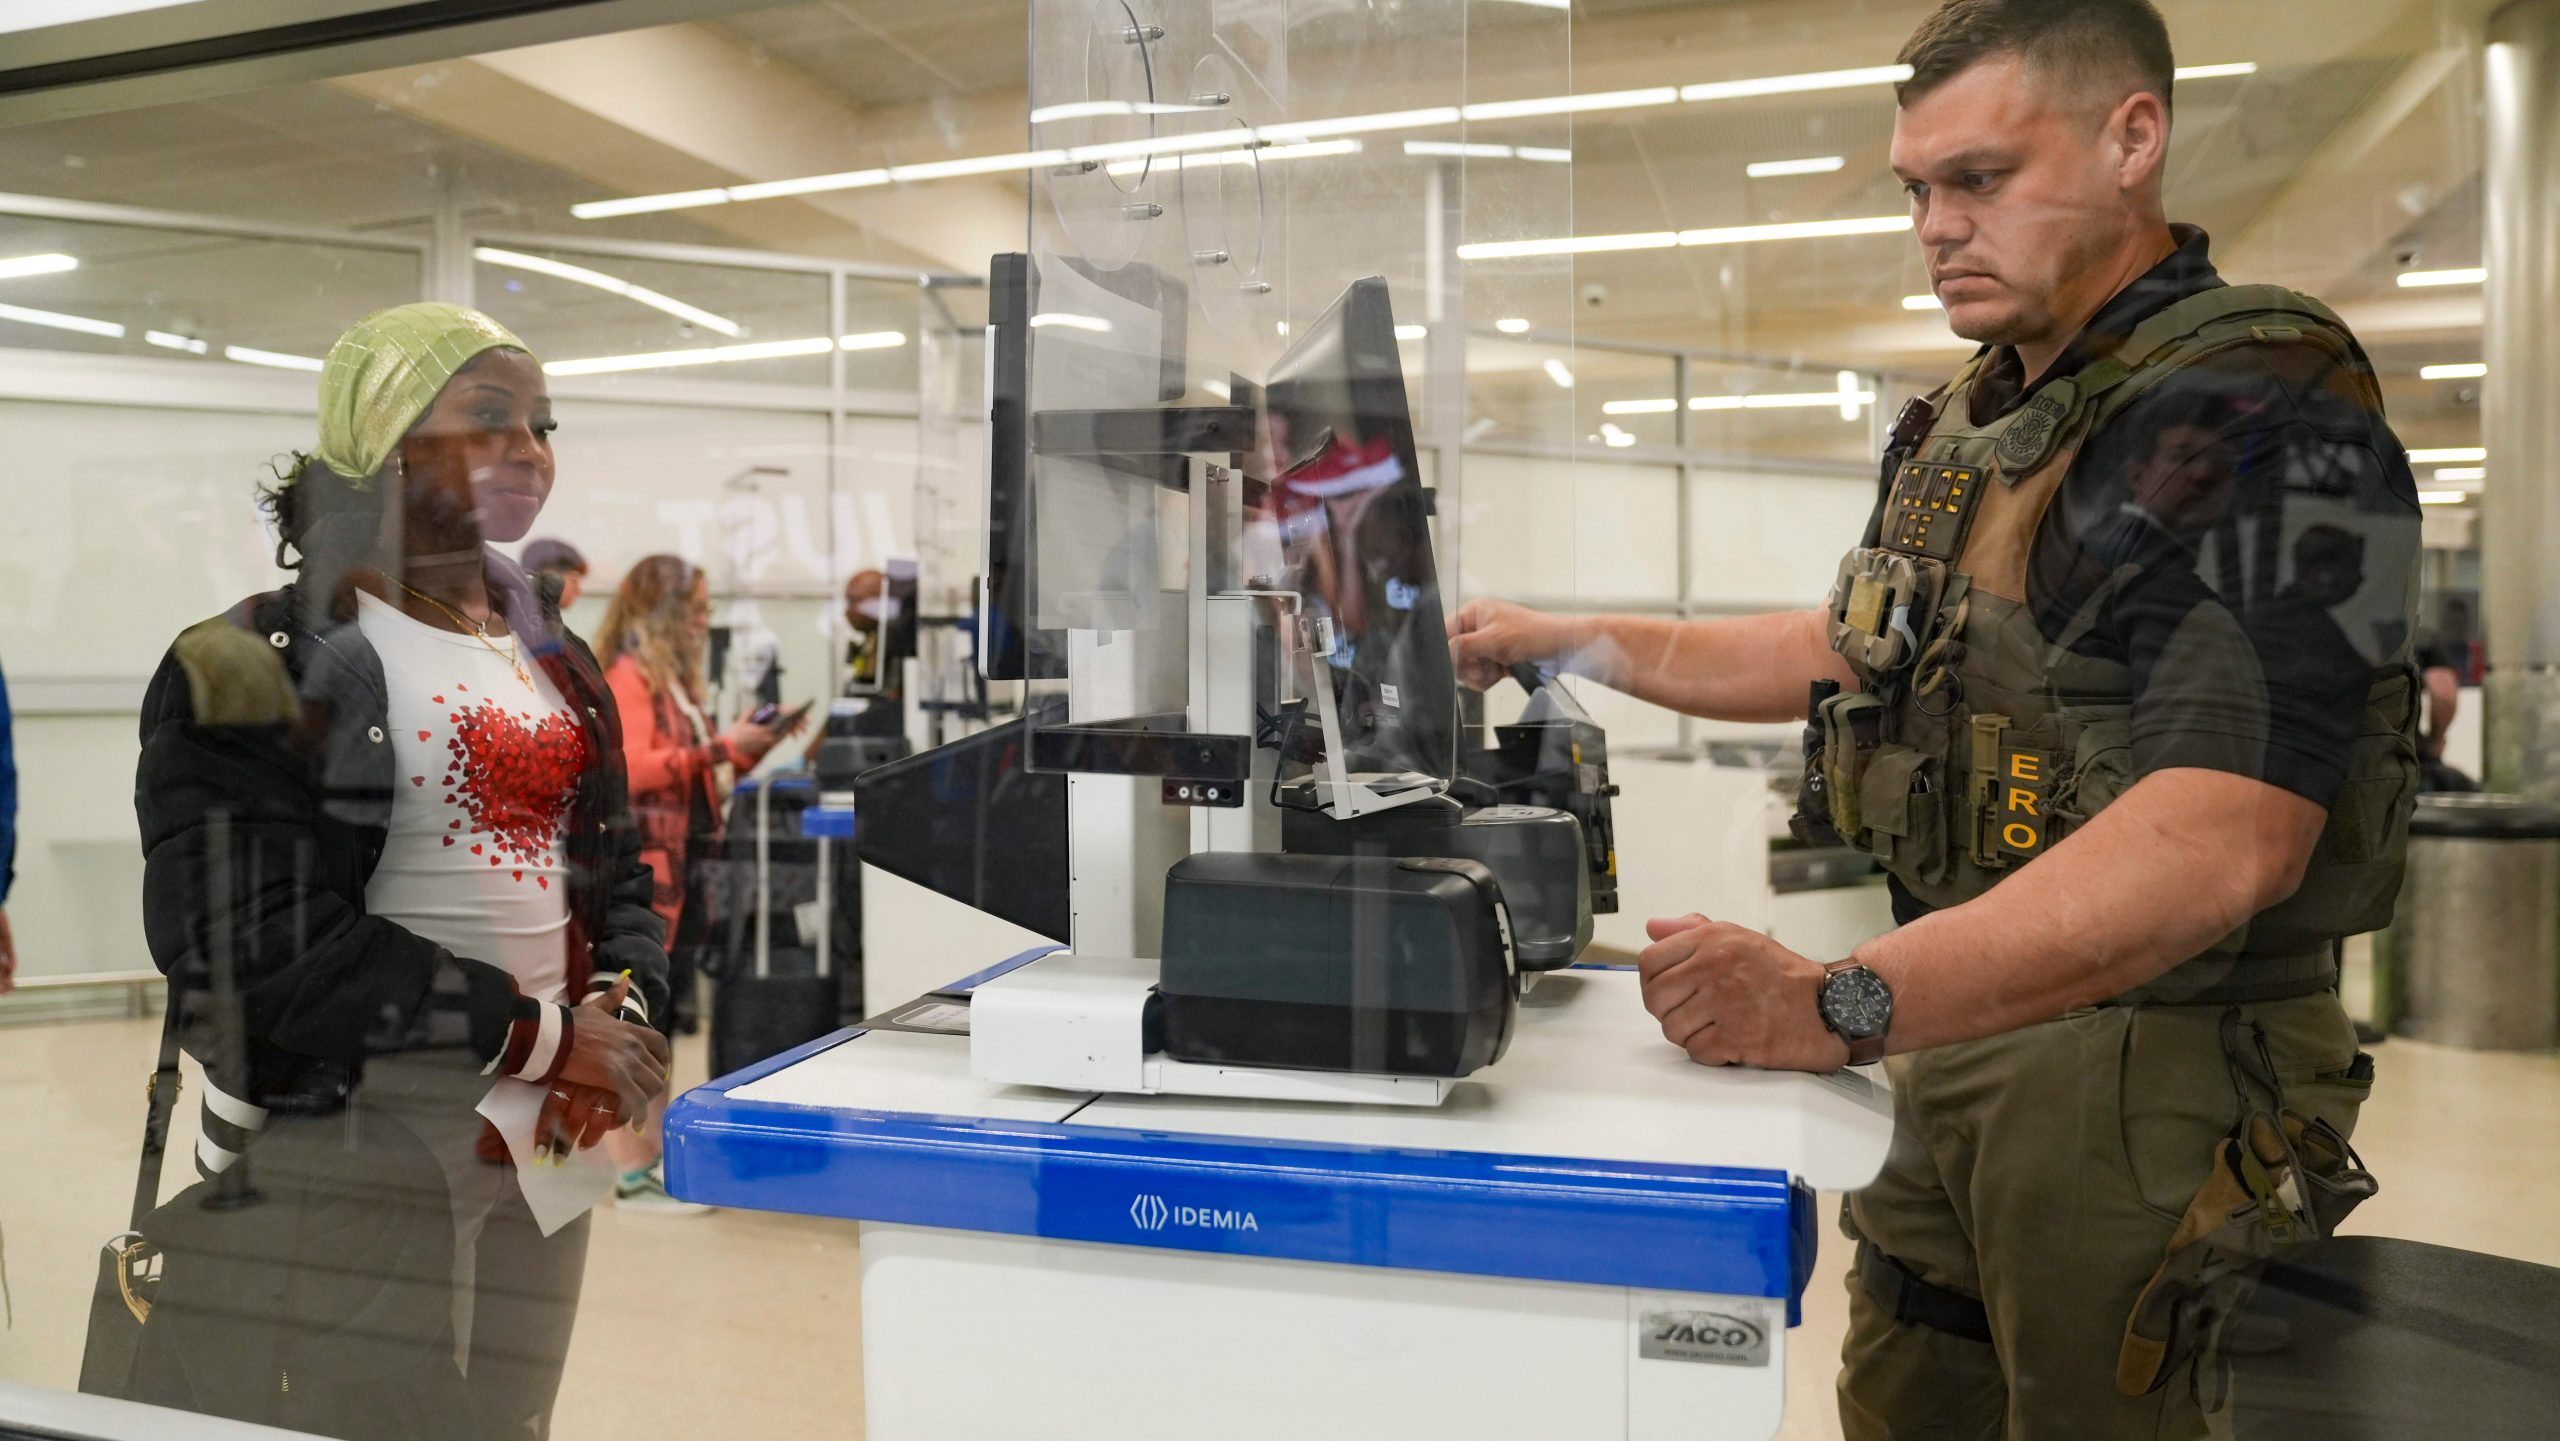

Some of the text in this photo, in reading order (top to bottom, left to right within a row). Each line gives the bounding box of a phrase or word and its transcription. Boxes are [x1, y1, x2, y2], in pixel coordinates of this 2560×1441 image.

[2037, 397, 2058, 413] ICE
[1895, 467, 1971, 513] POLICE
[1893, 513, 1933, 549] ICE
[2003, 753, 2039, 849] ERO
[1174, 1206, 1259, 1232] IDEMIA
[1655, 1324, 1747, 1346] JACO
